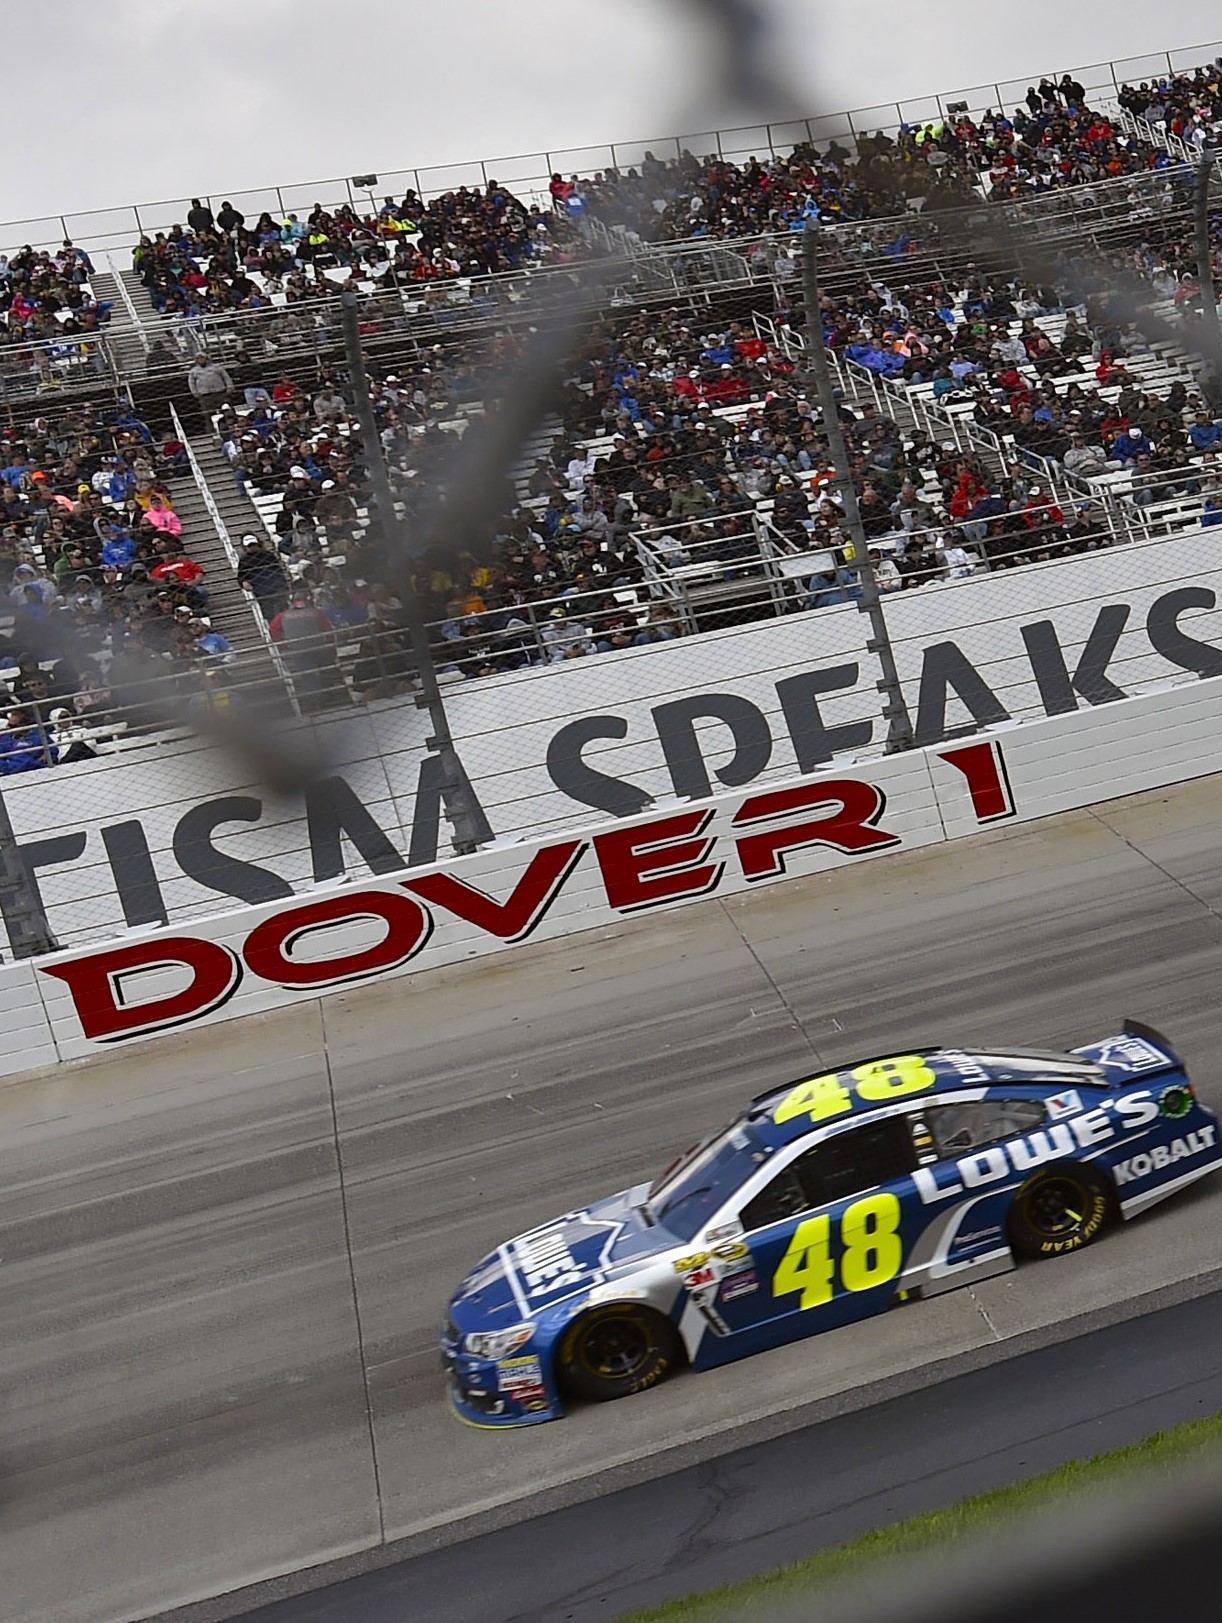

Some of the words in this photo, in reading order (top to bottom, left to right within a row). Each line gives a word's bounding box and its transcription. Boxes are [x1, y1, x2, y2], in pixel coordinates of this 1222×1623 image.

[38, 778, 901, 1043] DOVER
[773, 1055, 936, 1124] 48
[911, 1090, 1159, 1204] LOWE'S
[1112, 1125, 1216, 1186] KOBALT
[685, 1267, 715, 1288] 3M
[772, 1192, 902, 1310] 48
